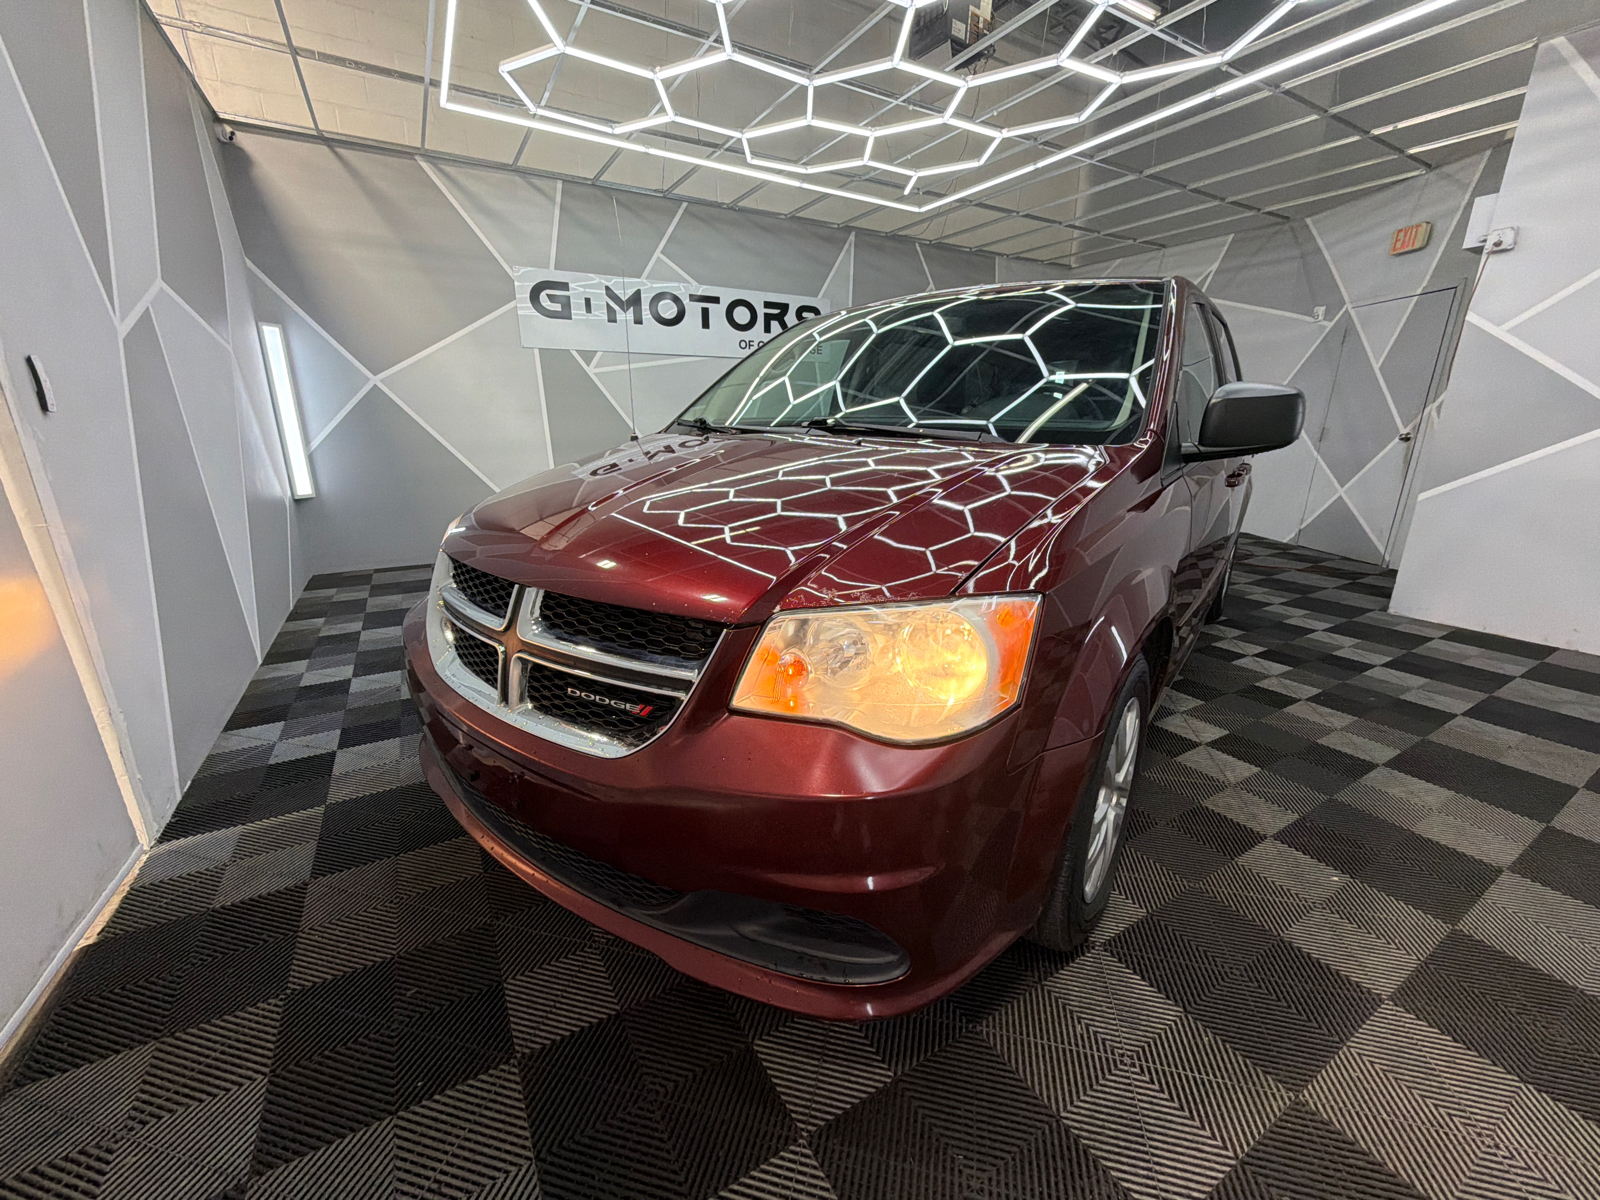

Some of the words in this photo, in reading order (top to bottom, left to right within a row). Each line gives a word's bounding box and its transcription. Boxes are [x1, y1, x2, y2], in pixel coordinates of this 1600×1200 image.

[1392, 224, 1421, 252] EXIT
[738, 339, 755, 350] OF
[567, 687, 640, 713] DODGE
